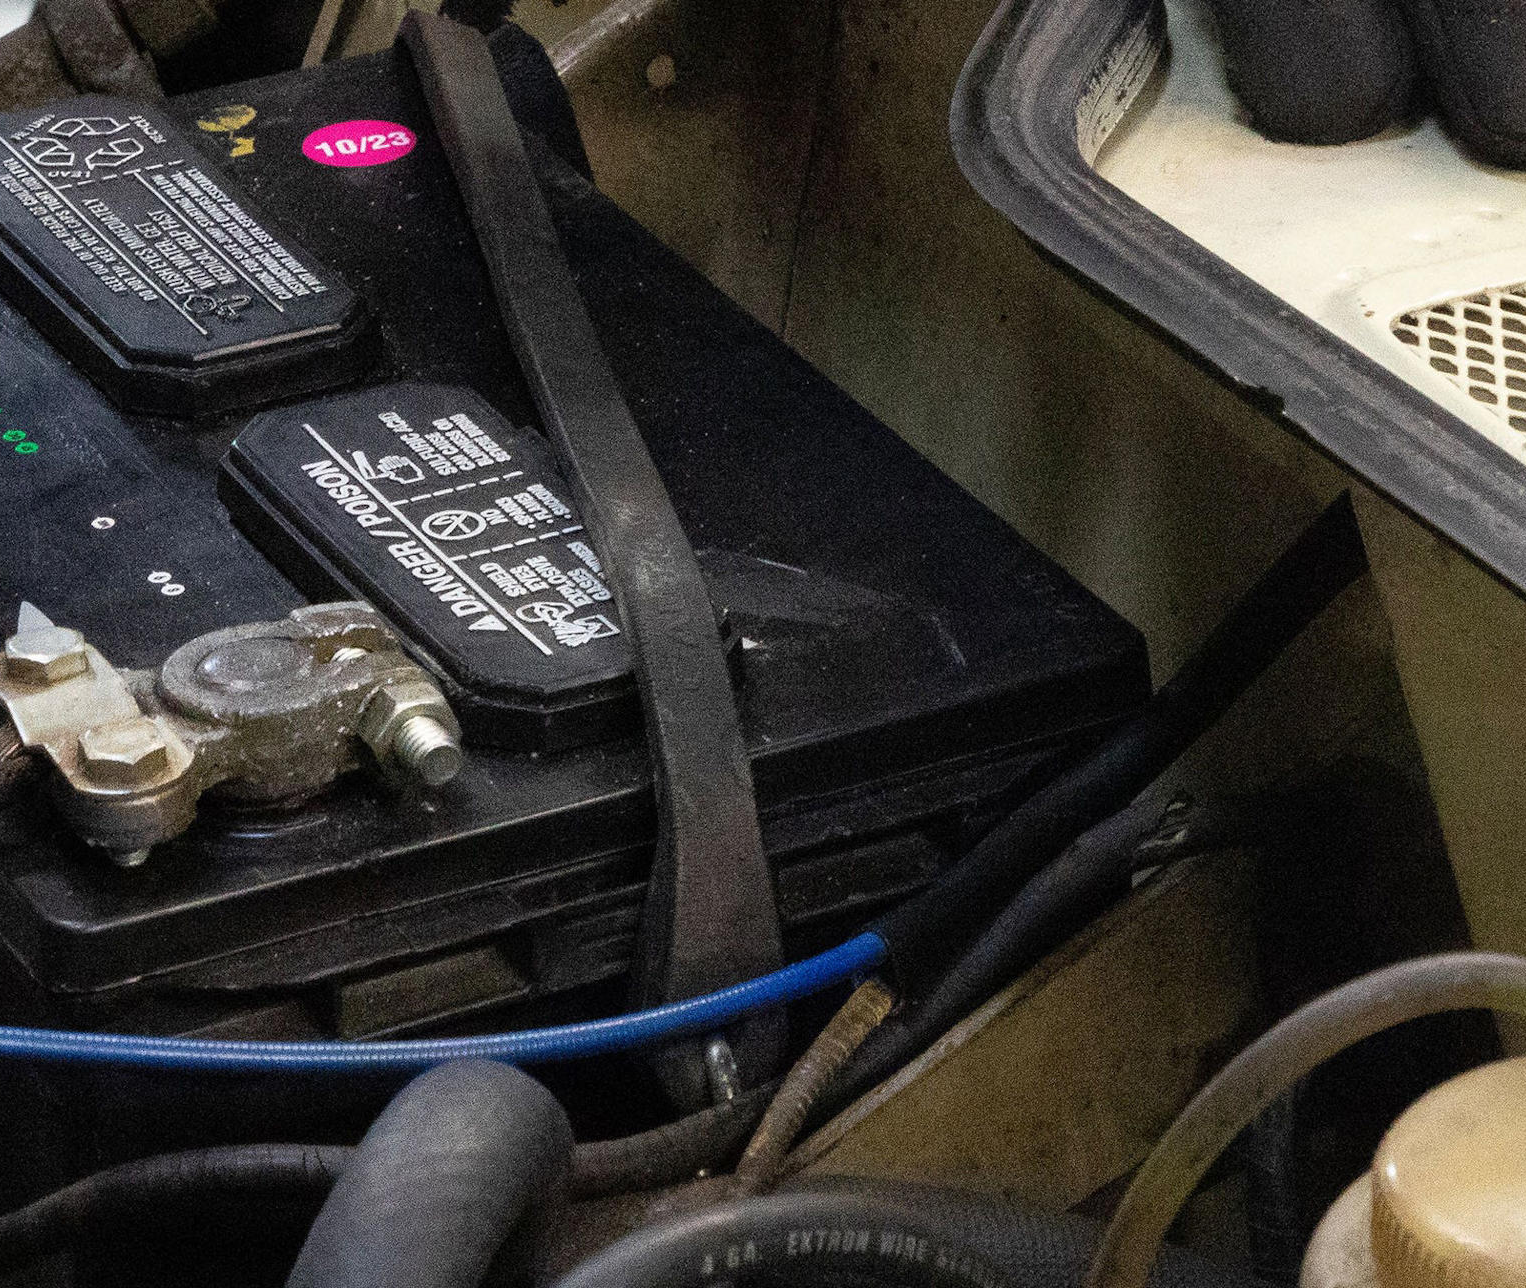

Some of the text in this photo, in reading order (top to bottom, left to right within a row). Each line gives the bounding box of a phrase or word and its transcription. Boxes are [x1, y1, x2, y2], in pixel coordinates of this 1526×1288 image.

[314, 131, 411, 157] 10/23
[152, 175, 184, 199] FOLLOW
[55, 210, 82, 229] CAPS
[176, 197, 215, 228] STARTING
[222, 202, 257, 228] SERVICE
[39, 215, 71, 239] REACH
[74, 228, 99, 246] VENT
[134, 222, 163, 239] GET
[206, 228, 233, 244] JUMP
[222, 222, 256, 248] VEHICLE
[249, 226, 273, 243] SEEK
[76, 251, 95, 261] OF
[82, 198, 195, 295] FLUSH EYES IMMEDIATELY
[92, 246, 117, 263] KEEP
[147, 210, 238, 285] MEDICAL HELP FAST
[224, 243, 250, 260] SAFE
[248, 246, 264, 255] IN
[264, 242, 308, 274] AVAILABLE
[86, 261, 110, 275] OUT
[183, 267, 216, 290] WITH
[241, 258, 263, 273] FOR
[256, 253, 310, 296] INSTRUCTIONS
[101, 276, 128, 293] KEEP
[124, 276, 147, 291] NOT
[298, 273, 321, 287] NOT
[311, 286, 327, 294] IF
[139, 290, 158, 301] DO
[379, 412, 458, 476] SULFURIC ACID
[433, 418, 495, 467] BLINDNESS OR
[450, 414, 511, 462] SEVERE BURNS
[425, 432, 476, 471] CAN CAUSE
[301, 460, 393, 528] POISON
[513, 493, 552, 521] FLAMES
[527, 484, 570, 516] SMOKING
[481, 509, 509, 525] NO
[495, 497, 535, 526] SPARKS
[388, 540, 489, 618] DANGER
[480, 563, 528, 597] SHIELD
[510, 565, 550, 592] EYES
[525, 556, 593, 608] EXPLOSIVE
[567, 568, 611, 601] GASES
